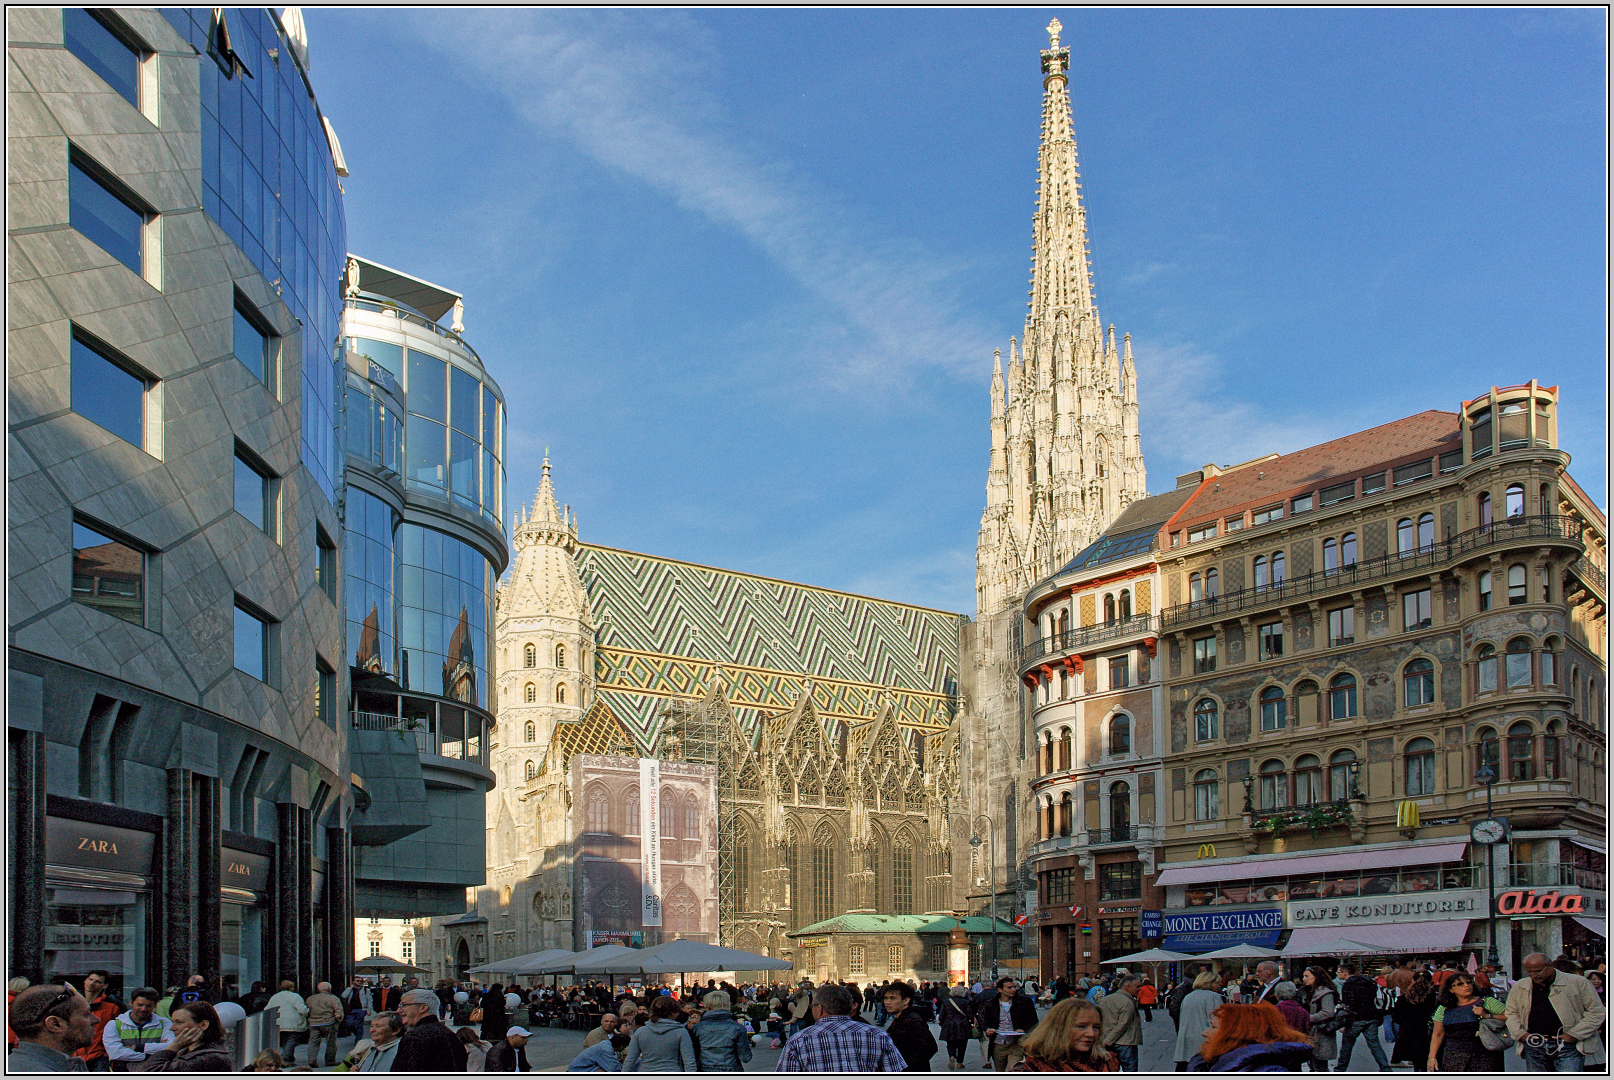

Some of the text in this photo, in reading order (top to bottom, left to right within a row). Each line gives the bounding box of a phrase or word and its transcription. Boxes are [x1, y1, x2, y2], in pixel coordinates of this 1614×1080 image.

[77, 837, 118, 855] ZARA
[228, 862, 250, 876] ZARA
[1293, 898, 1475, 921] CAFE KONDITOREI
[1142, 920, 1162, 928] CHANGE
[1164, 912, 1282, 932] MONEY EXCHANGE
[1194, 932, 1236, 941] CHANGE
[1236, 931, 1272, 939] GROUP
